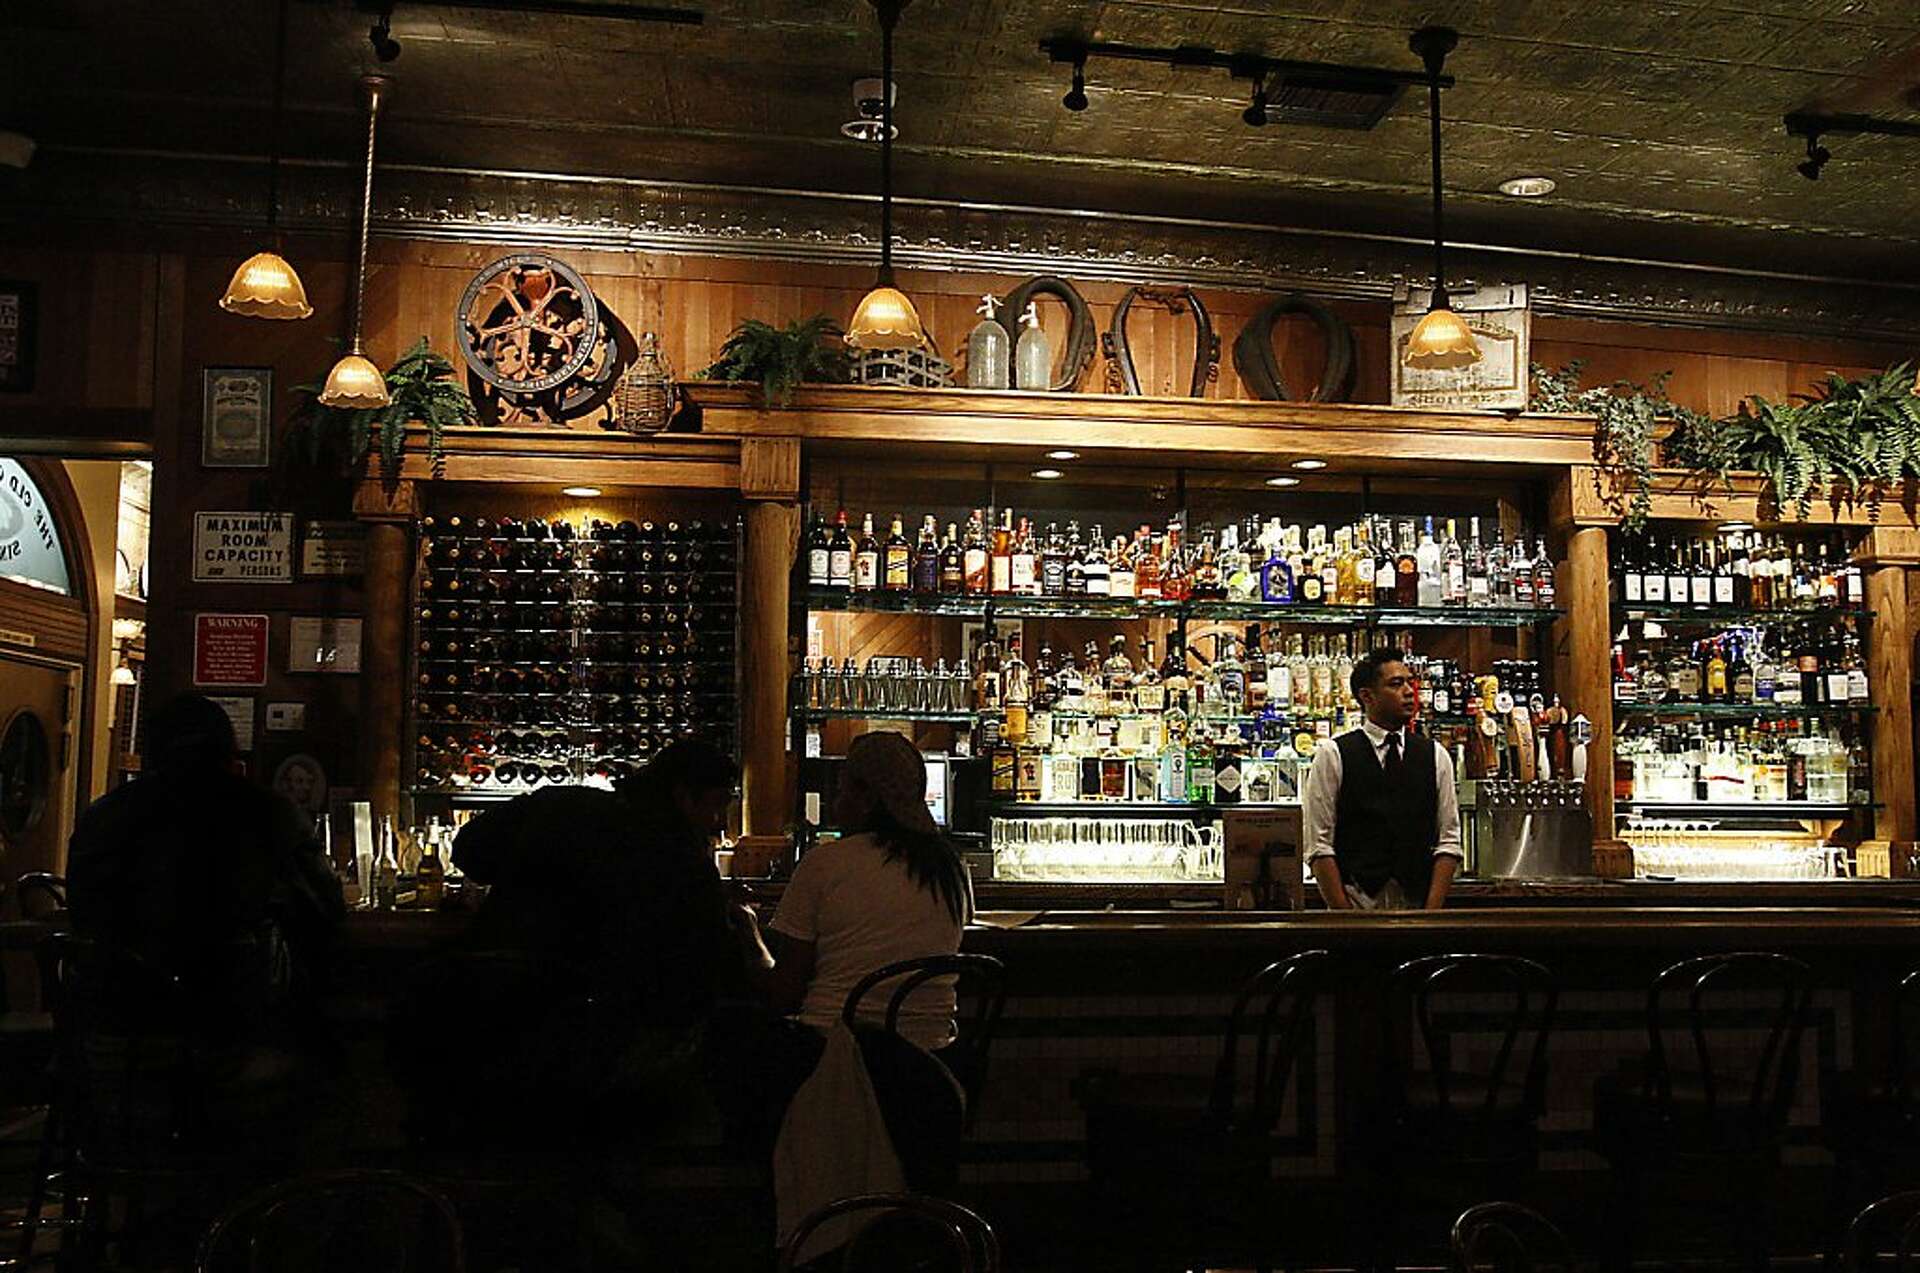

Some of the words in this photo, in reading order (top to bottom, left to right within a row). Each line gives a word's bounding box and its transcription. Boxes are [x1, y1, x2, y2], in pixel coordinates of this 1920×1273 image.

[206, 519, 283, 531] MAXIMUM
[221, 534, 269, 546] ROOM
[205, 549, 283, 562] CAPACITY
[207, 617, 259, 628] WARNING
